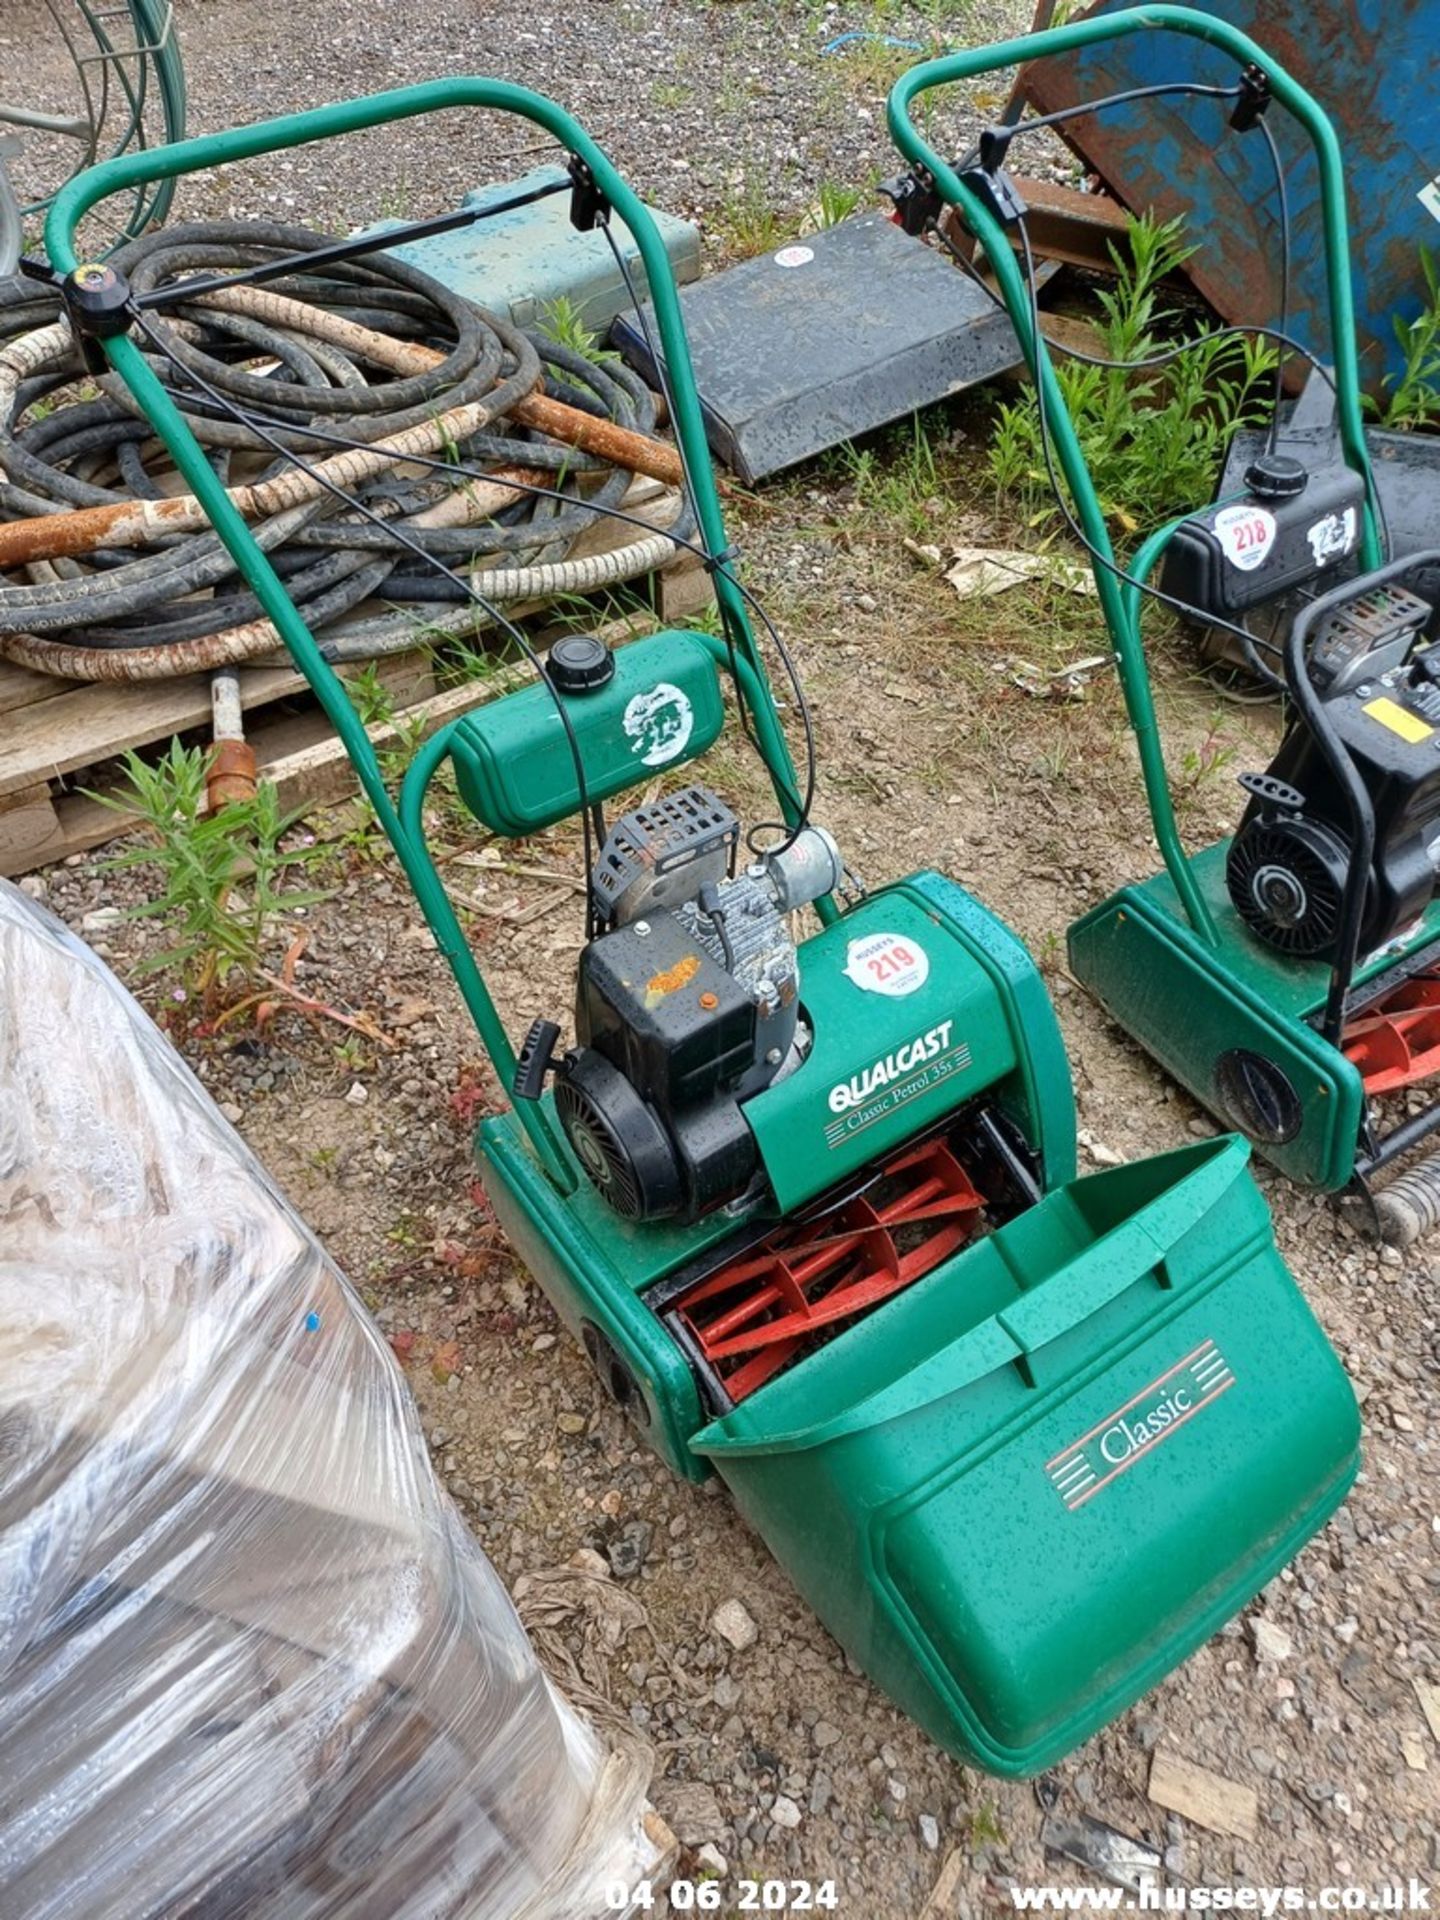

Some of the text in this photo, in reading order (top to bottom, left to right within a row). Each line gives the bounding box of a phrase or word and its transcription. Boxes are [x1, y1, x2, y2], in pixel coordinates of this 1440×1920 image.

[1232, 519, 1266, 551] 218
[867, 946, 915, 981] 219
[828, 1019, 953, 1113] QUALCAST
[847, 1060, 953, 1129] Classic Petrol 35s
[1100, 1388, 1192, 1463] Classic
